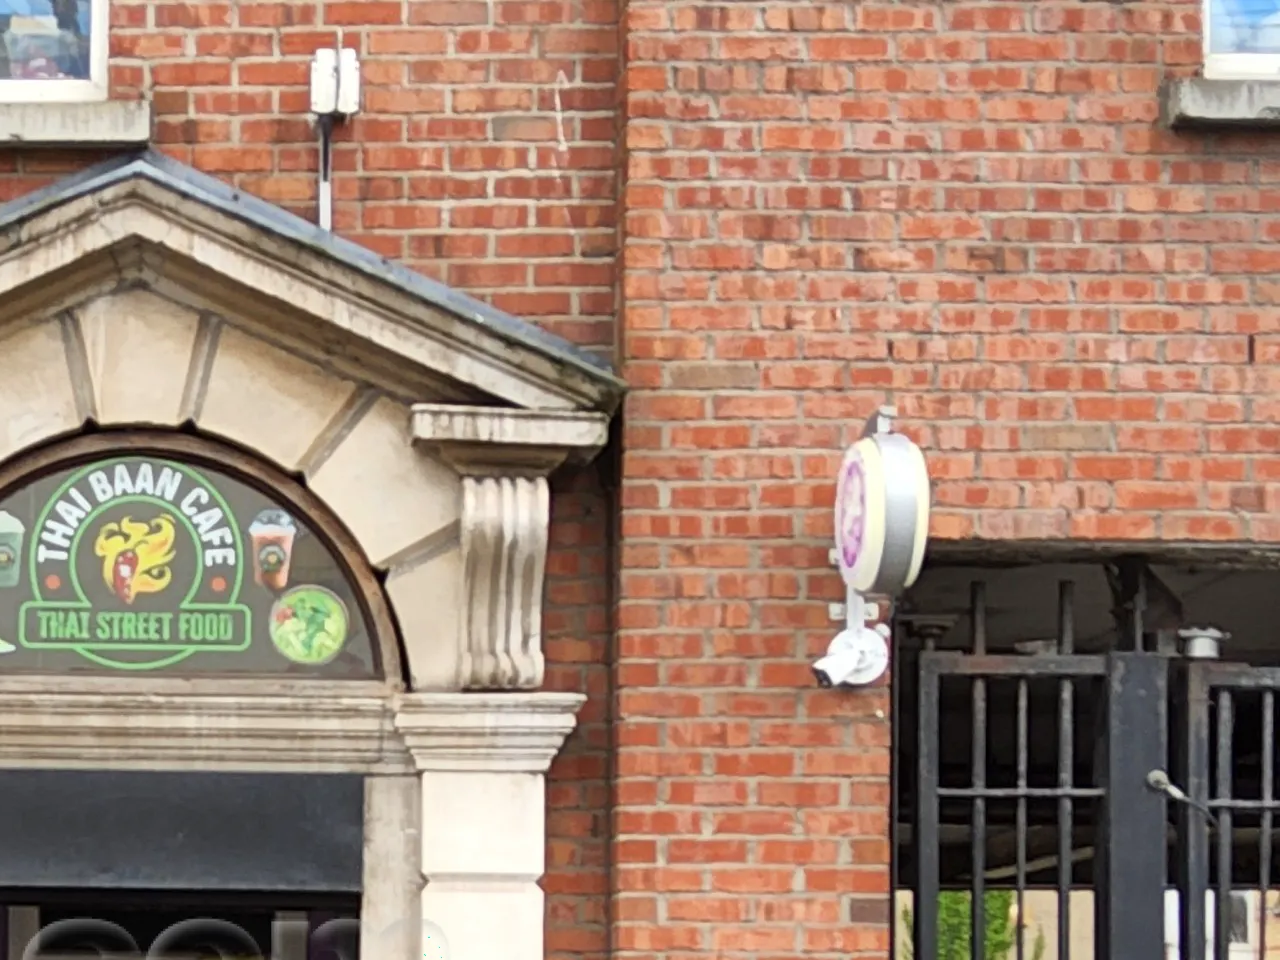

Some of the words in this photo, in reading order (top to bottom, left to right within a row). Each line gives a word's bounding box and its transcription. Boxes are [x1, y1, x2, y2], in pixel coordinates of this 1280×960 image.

[37, 487, 92, 563] THAI
[88, 464, 182, 503] BAAN
[180, 487, 235, 567] CAFE
[36, 611, 91, 639] THAI
[95, 612, 173, 640] STREET
[178, 613, 233, 641] FOOD
